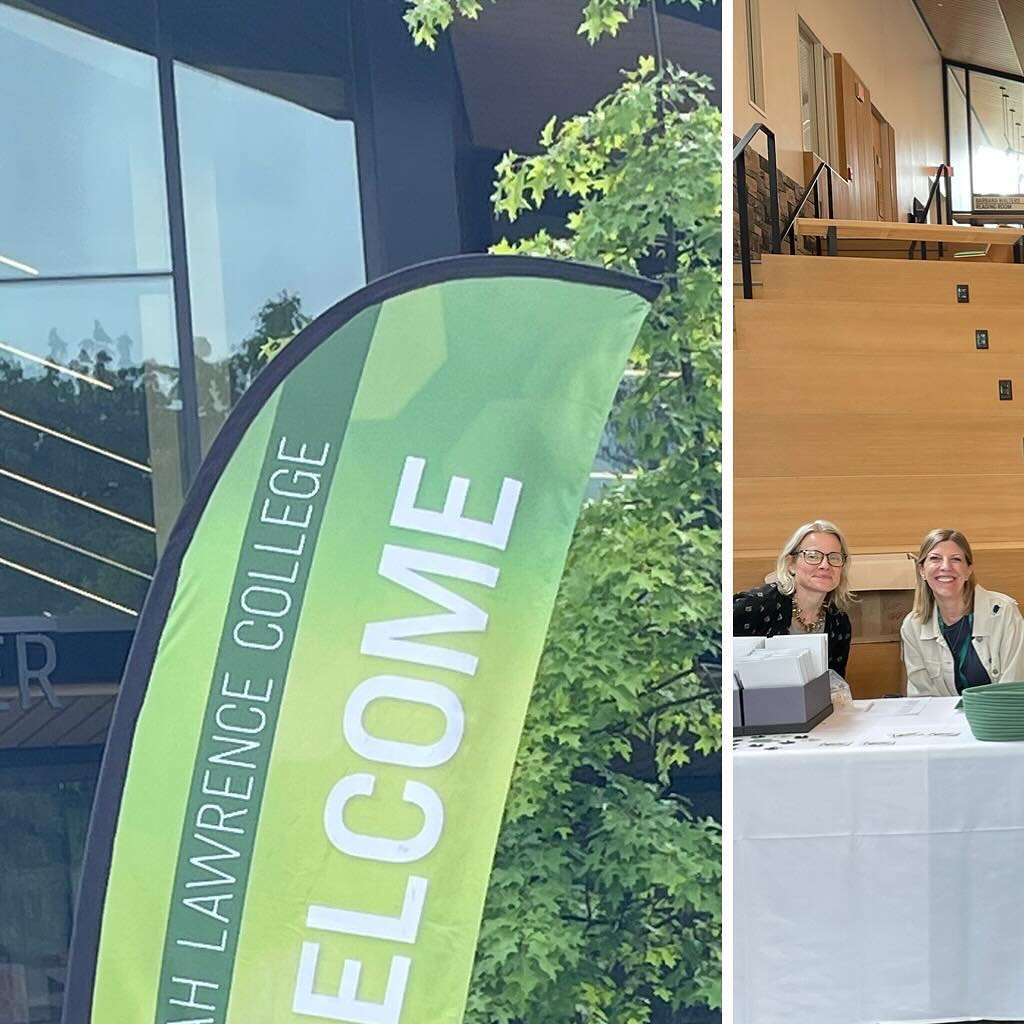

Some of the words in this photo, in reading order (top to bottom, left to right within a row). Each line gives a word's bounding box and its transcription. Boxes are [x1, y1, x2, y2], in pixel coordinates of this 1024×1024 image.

[0, 633, 63, 710] R
[176, 672, 274, 951] LAWRENCE
[233, 436, 331, 651] COLLEGE
